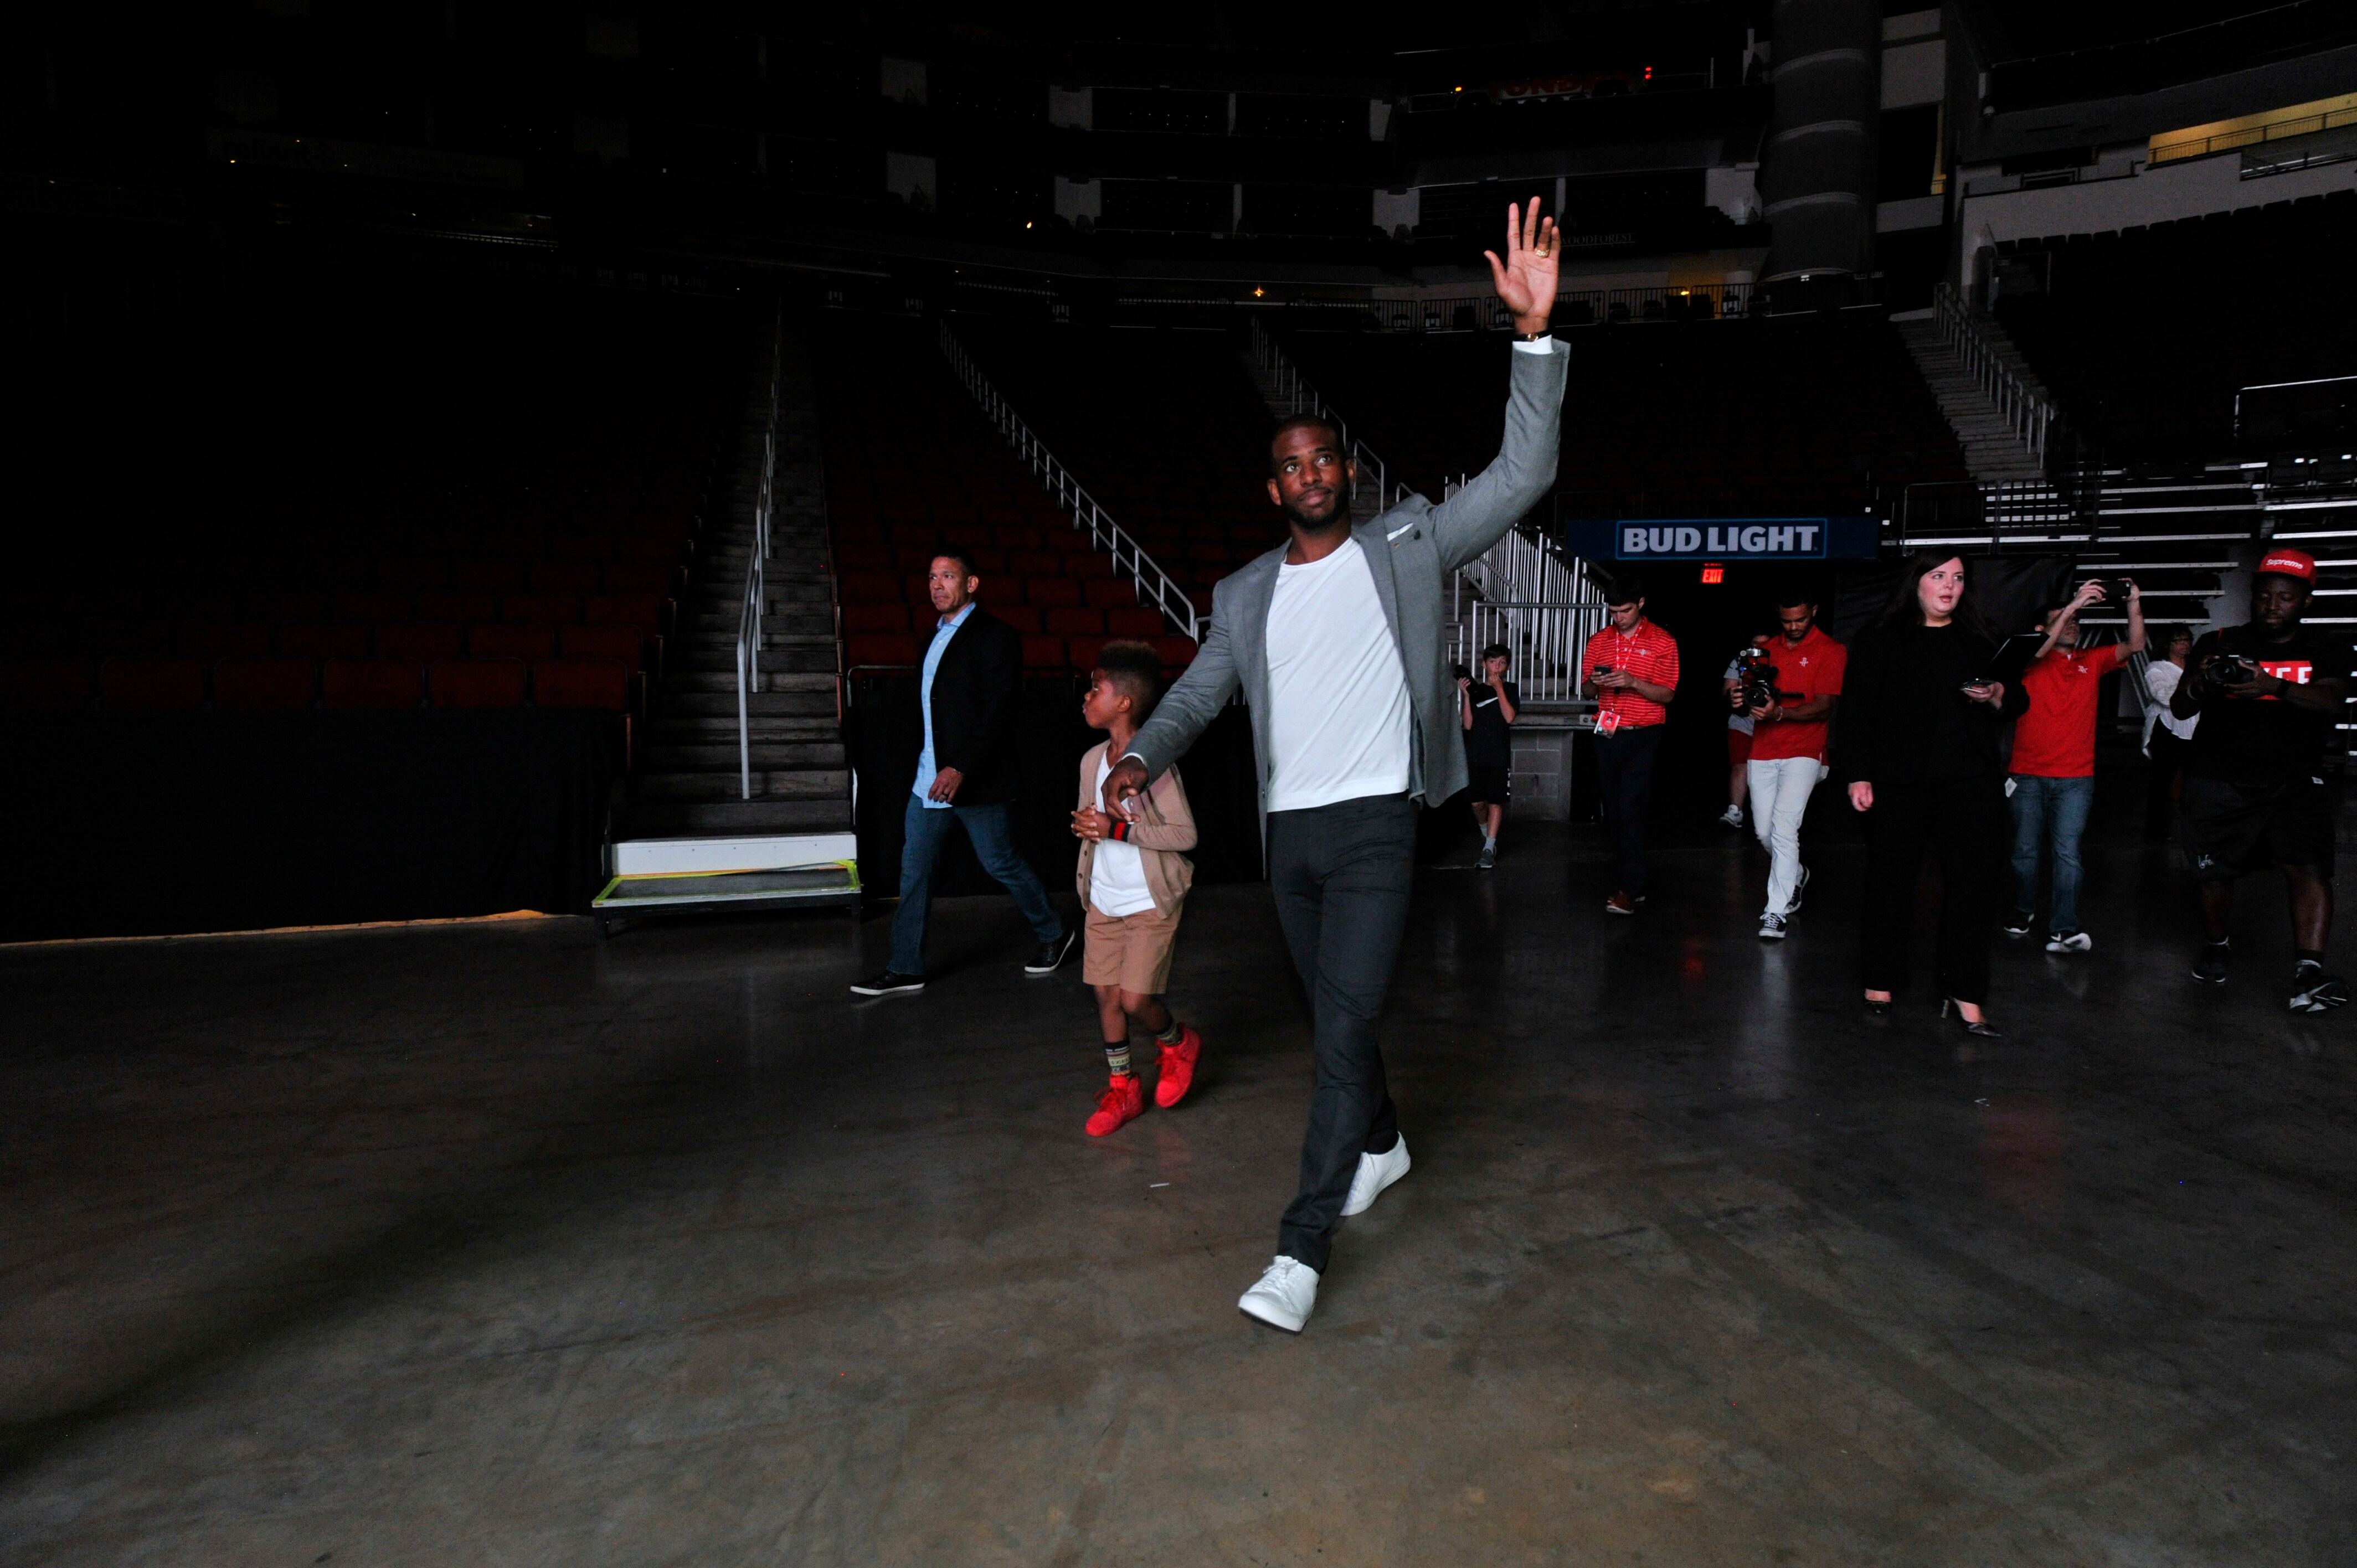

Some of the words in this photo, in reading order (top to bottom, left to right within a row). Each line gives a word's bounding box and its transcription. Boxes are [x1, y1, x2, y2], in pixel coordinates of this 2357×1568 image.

[1624, 527, 1701, 552] BUD
[1707, 526, 1819, 552] LIGHT
[2266, 559, 2304, 569] Supreme
[1702, 569, 1723, 583] EXIT
